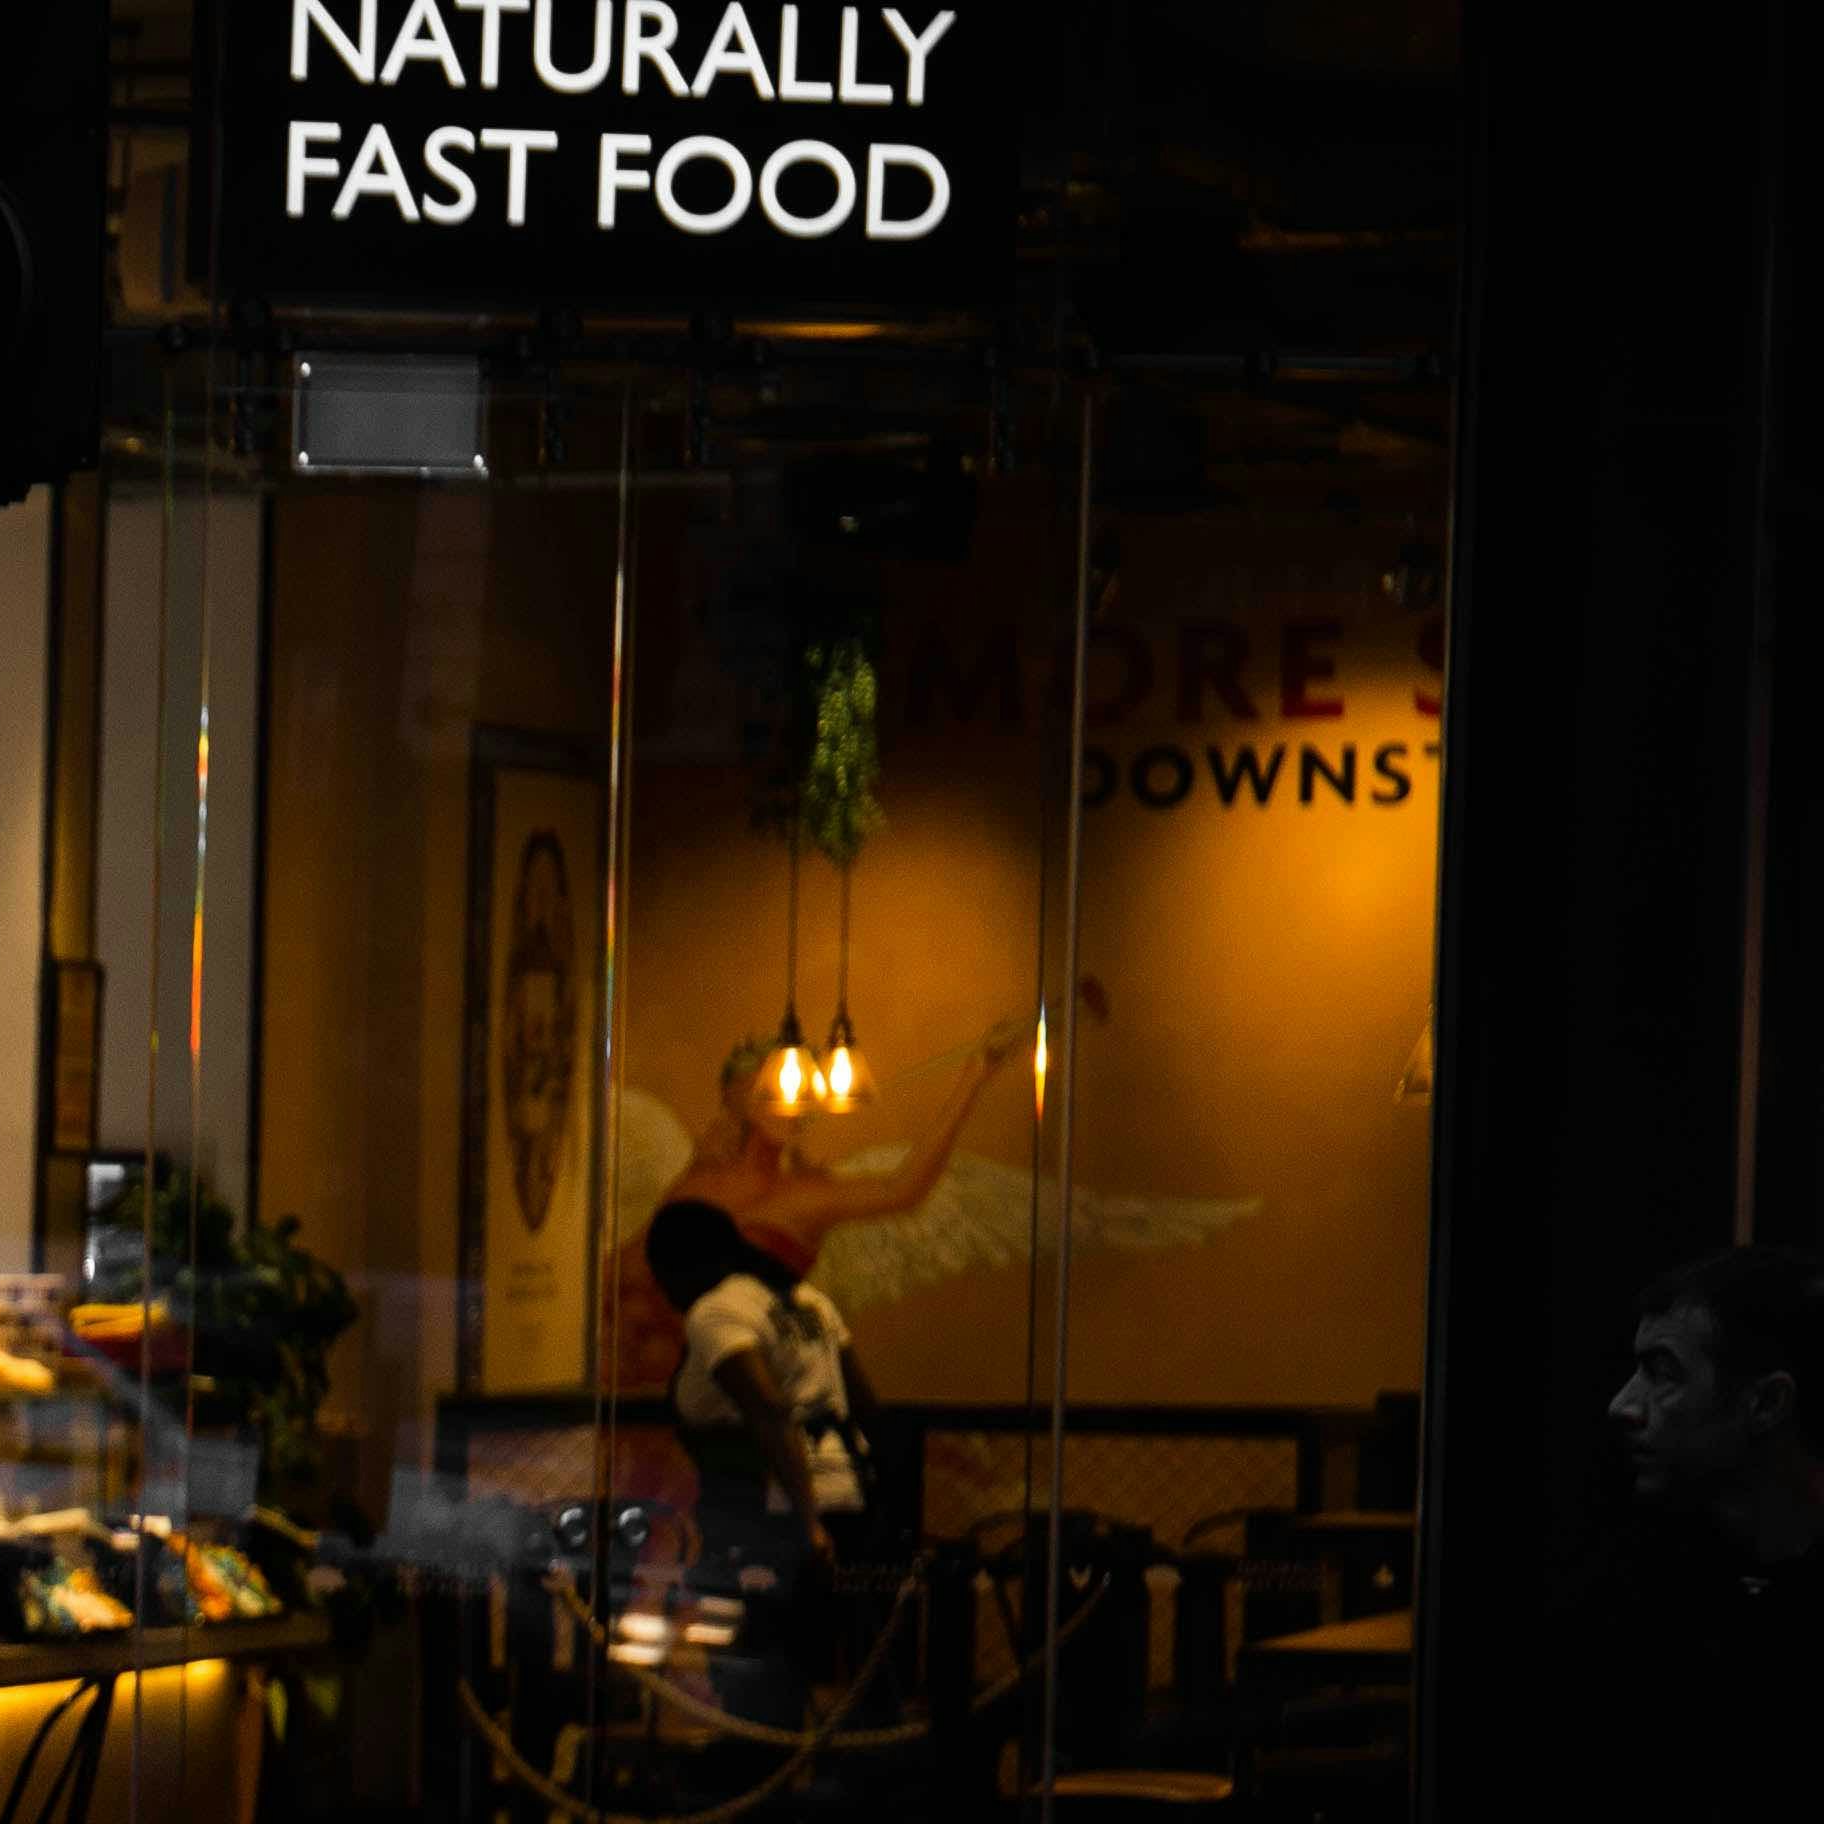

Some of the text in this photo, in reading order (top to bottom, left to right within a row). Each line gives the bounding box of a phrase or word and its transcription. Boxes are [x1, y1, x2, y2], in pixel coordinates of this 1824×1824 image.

[288, 0, 958, 108] NATURALLY
[284, 118, 952, 243] FAST FOOD
[1078, 742, 1440, 808] DOWNS
